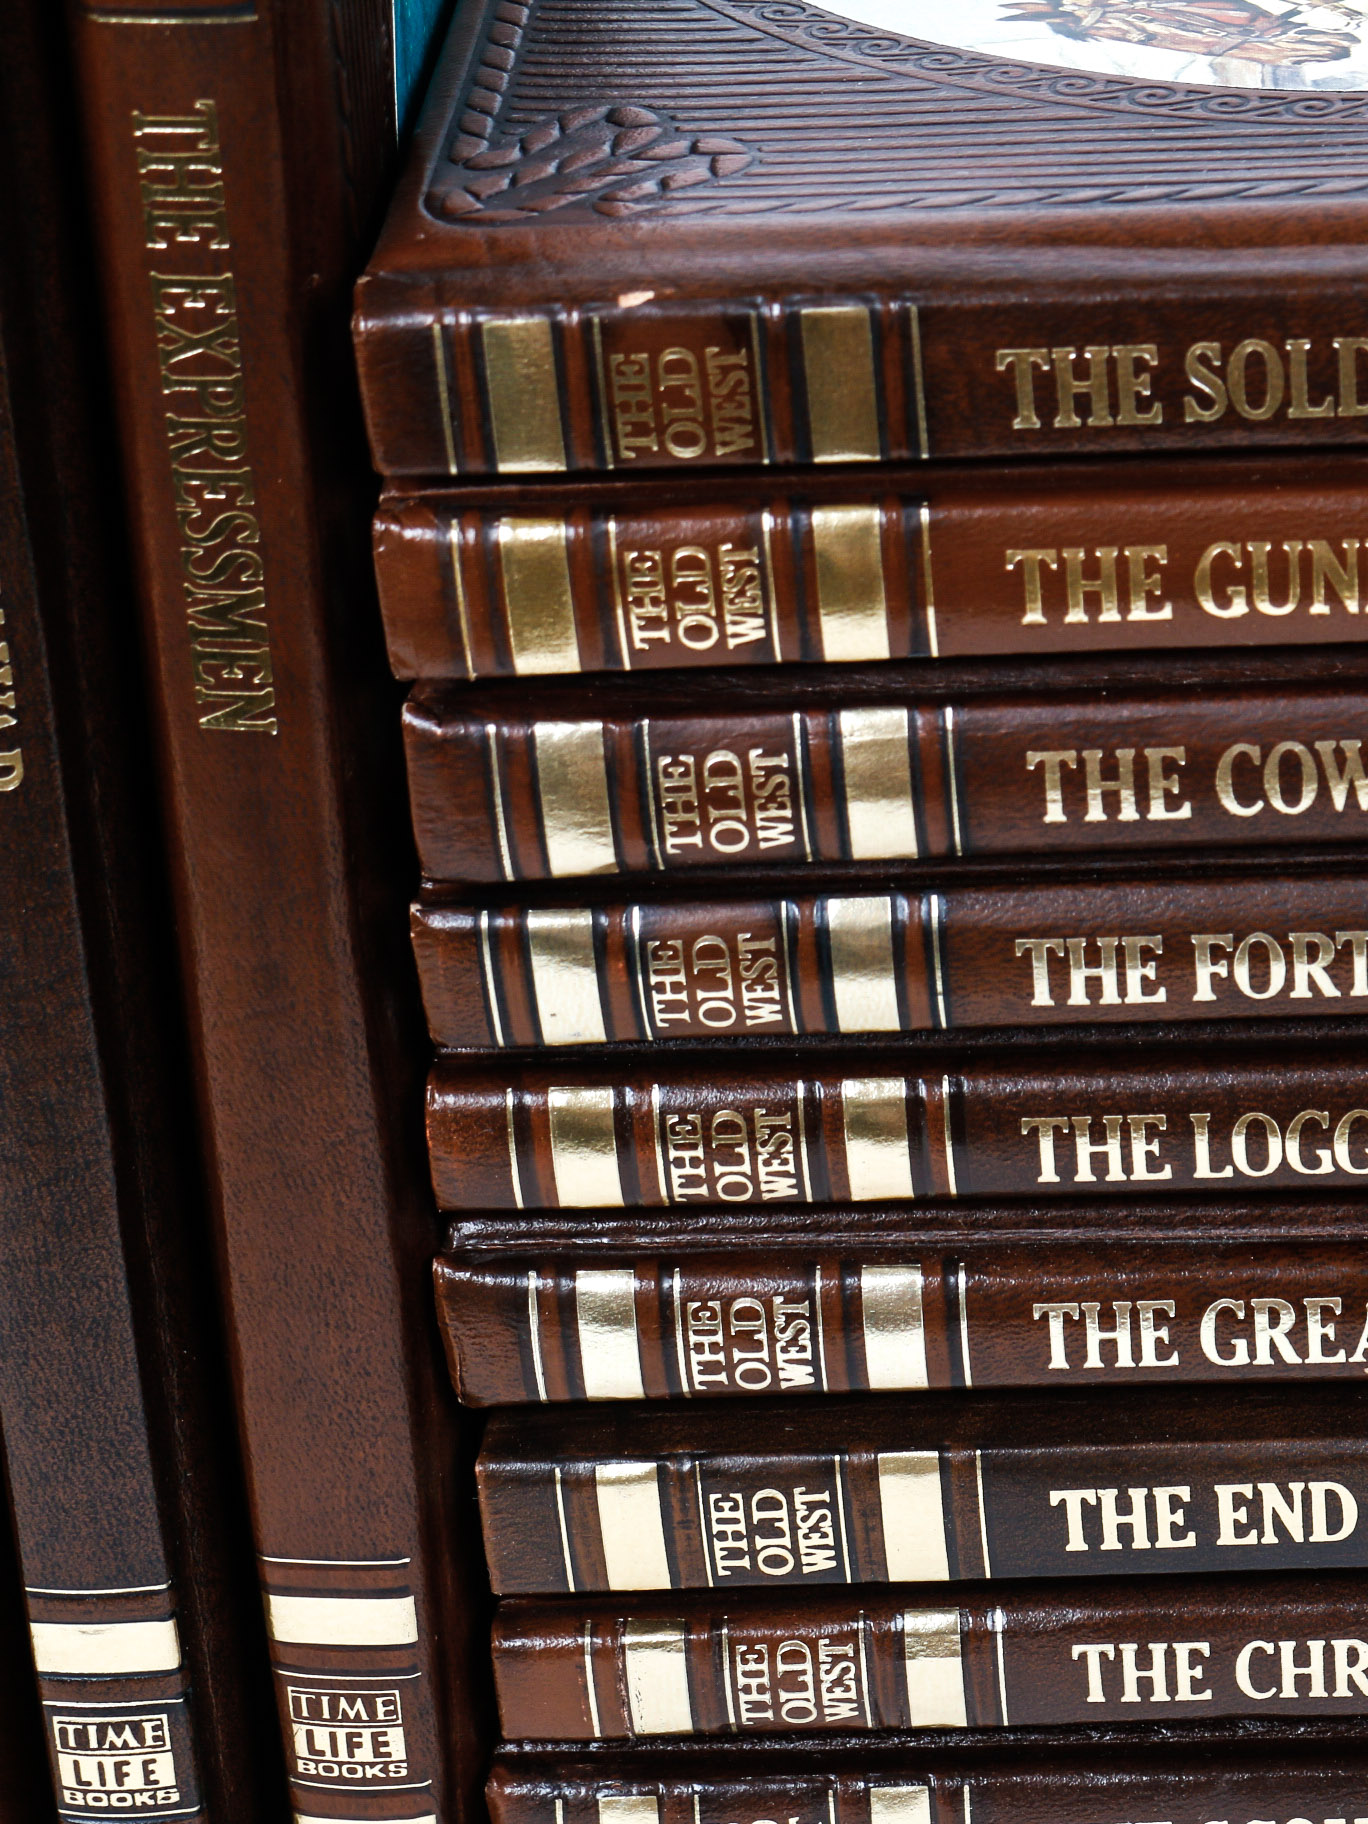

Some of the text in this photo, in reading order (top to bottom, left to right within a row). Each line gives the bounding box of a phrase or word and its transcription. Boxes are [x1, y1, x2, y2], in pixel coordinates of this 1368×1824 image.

[132, 99, 277, 735] THE EXPRESSMEN
[610, 353, 658, 459] THE
[658, 347, 706, 458] OLD
[705, 346, 754, 456] WEST
[996, 343, 1162, 430] THE
[624, 551, 670, 649] THE
[672, 546, 719, 650] OLD
[718, 543, 766, 649] WEST
[1005, 544, 1173, 626] THE
[658, 755, 703, 854] THE
[704, 750, 749, 852] OLD
[749, 748, 795, 849] WEST
[1026, 746, 1193, 824] THE
[647, 939, 691, 1027] THE
[692, 935, 736, 1027] OLD
[737, 933, 782, 1026] WEST
[1015, 934, 1167, 1007] THE
[666, 1114, 709, 1201] THE
[712, 1110, 753, 1201] OLD
[754, 1108, 798, 1200] WEST
[1021, 1114, 1173, 1184] THE
[687, 1301, 728, 1390] THE
[730, 1297, 771, 1389] OLD
[773, 1295, 815, 1388] WEST
[1032, 1299, 1179, 1371] THE
[709, 1493, 750, 1576] THE
[752, 1489, 795, 1575] OLD
[794, 1487, 837, 1574] WEST
[1049, 1485, 1196, 1553] THE
[1214, 1479, 1359, 1546] END
[298, 1694, 398, 1721] TIME
[736, 1644, 773, 1724] THE
[776, 1640, 817, 1723] OLD
[819, 1639, 858, 1722] WEST
[1071, 1641, 1212, 1704] THE
[57, 1721, 164, 1750] TIME
[73, 1758, 161, 1787] LIFE
[298, 1760, 408, 1779] BOOKS
[306, 1728, 392, 1759] LIFE
[63, 1788, 180, 1806] BOOKS
